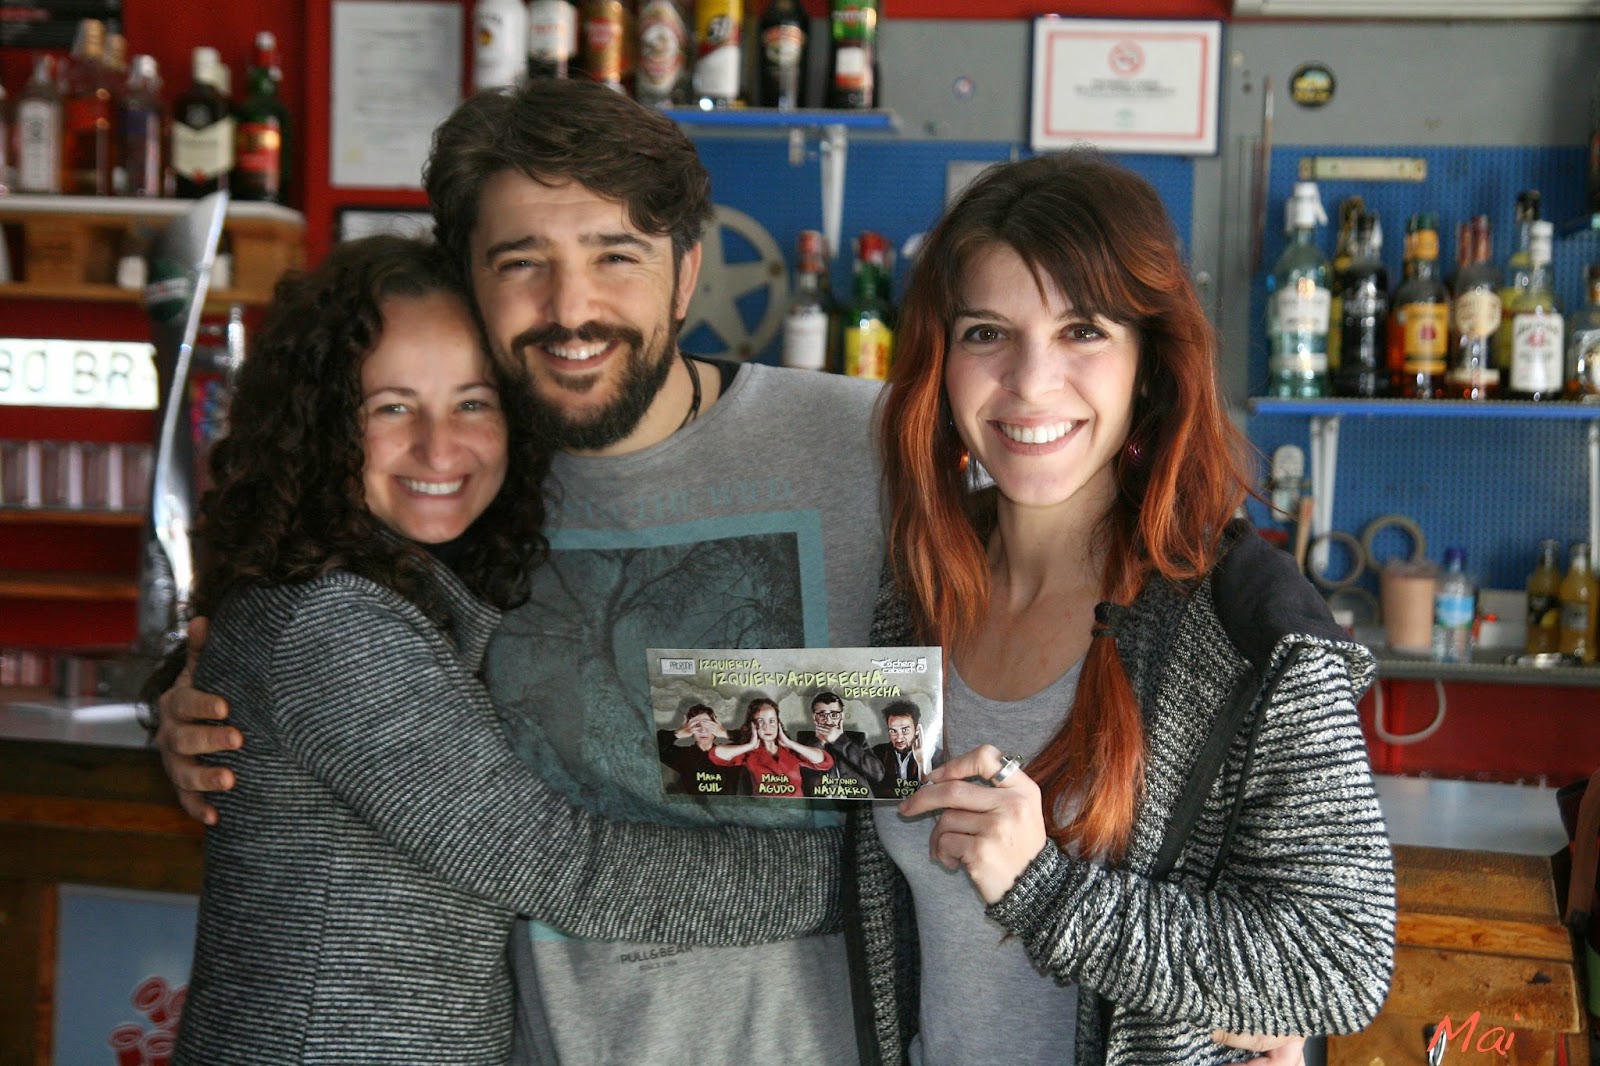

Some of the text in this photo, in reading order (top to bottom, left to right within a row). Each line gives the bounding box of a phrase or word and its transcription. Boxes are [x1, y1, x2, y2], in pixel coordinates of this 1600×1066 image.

[845, 686, 901, 698] DERECHA
[698, 782, 723, 793] GUIL
[759, 783, 796, 794] AGUDO
[814, 785, 868, 796] NAVARRO
[621, 943, 693, 964] PULL&BEAR
